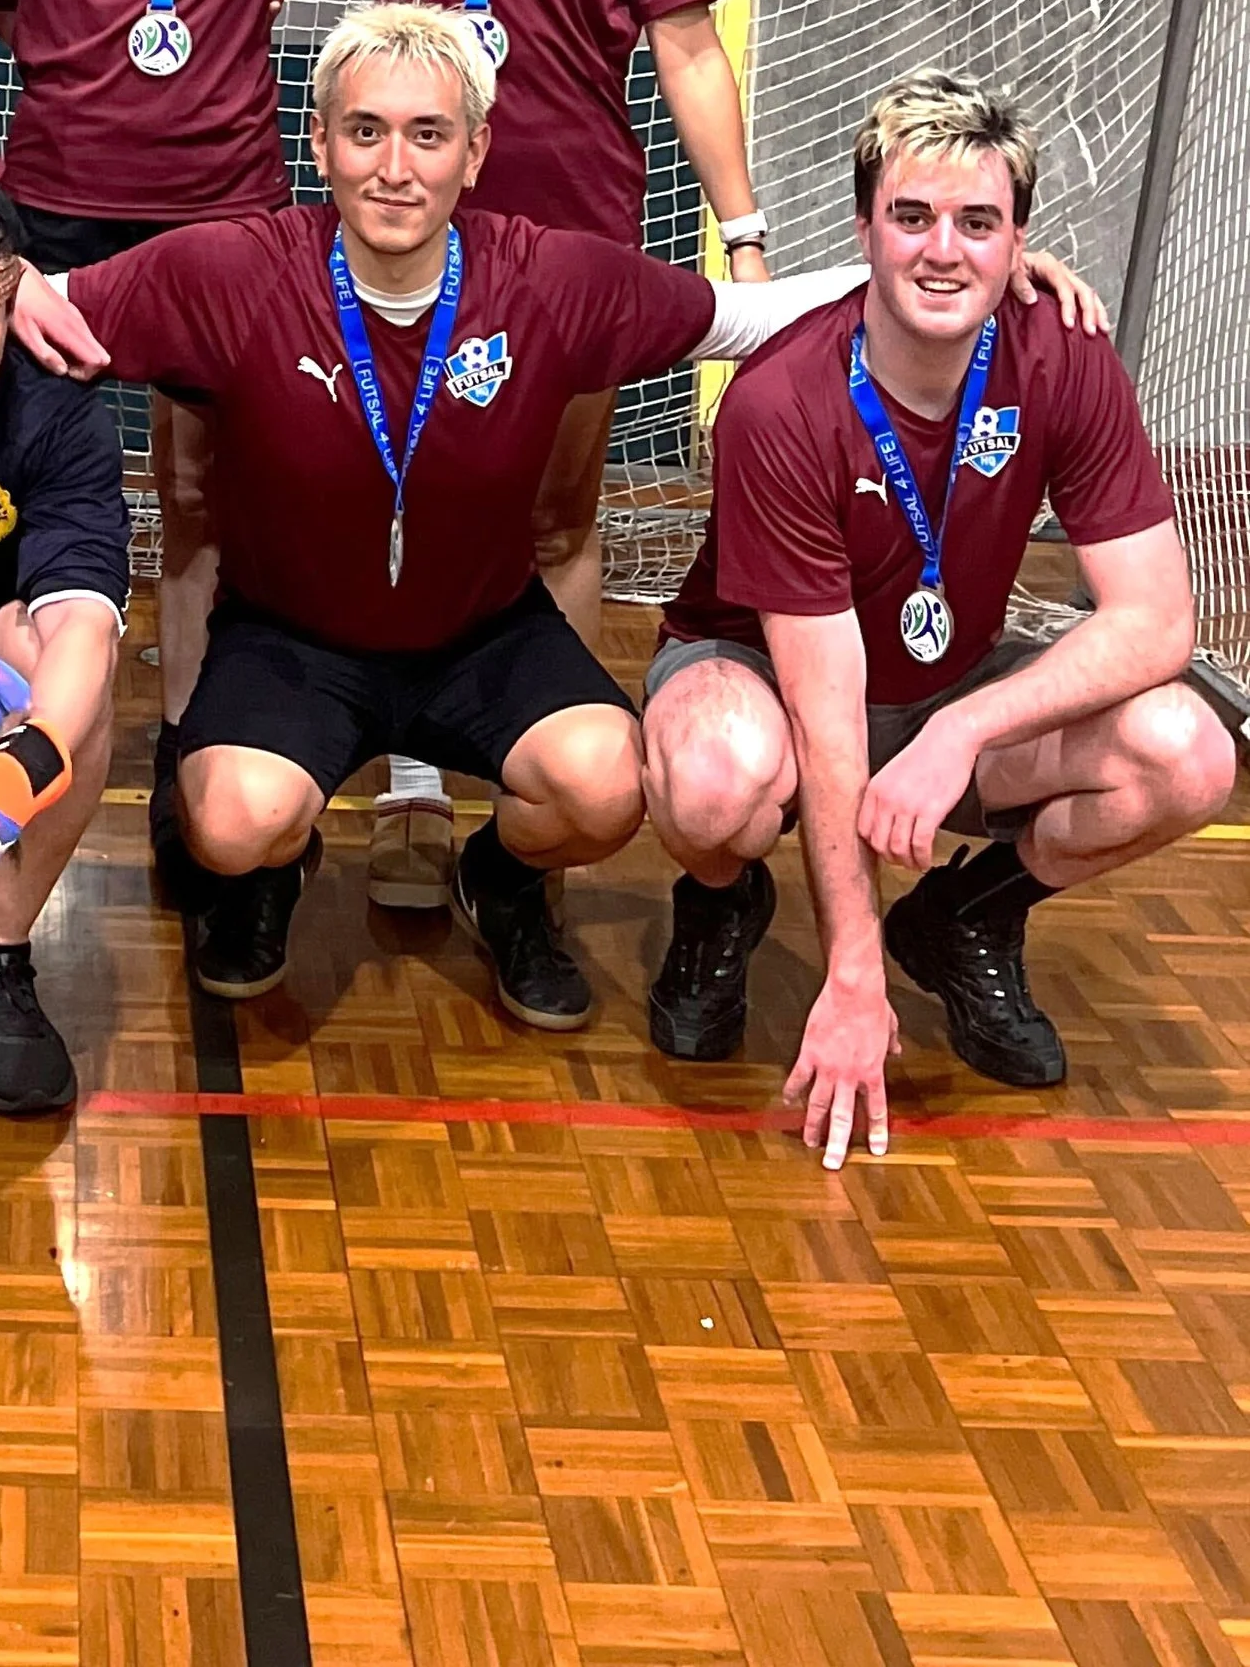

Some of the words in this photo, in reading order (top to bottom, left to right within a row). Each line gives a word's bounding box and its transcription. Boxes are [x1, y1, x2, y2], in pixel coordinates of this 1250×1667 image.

[454, 364, 504, 391] FUTSAL
[416, 402, 429, 416] 4
[379, 432, 390, 444] 4
